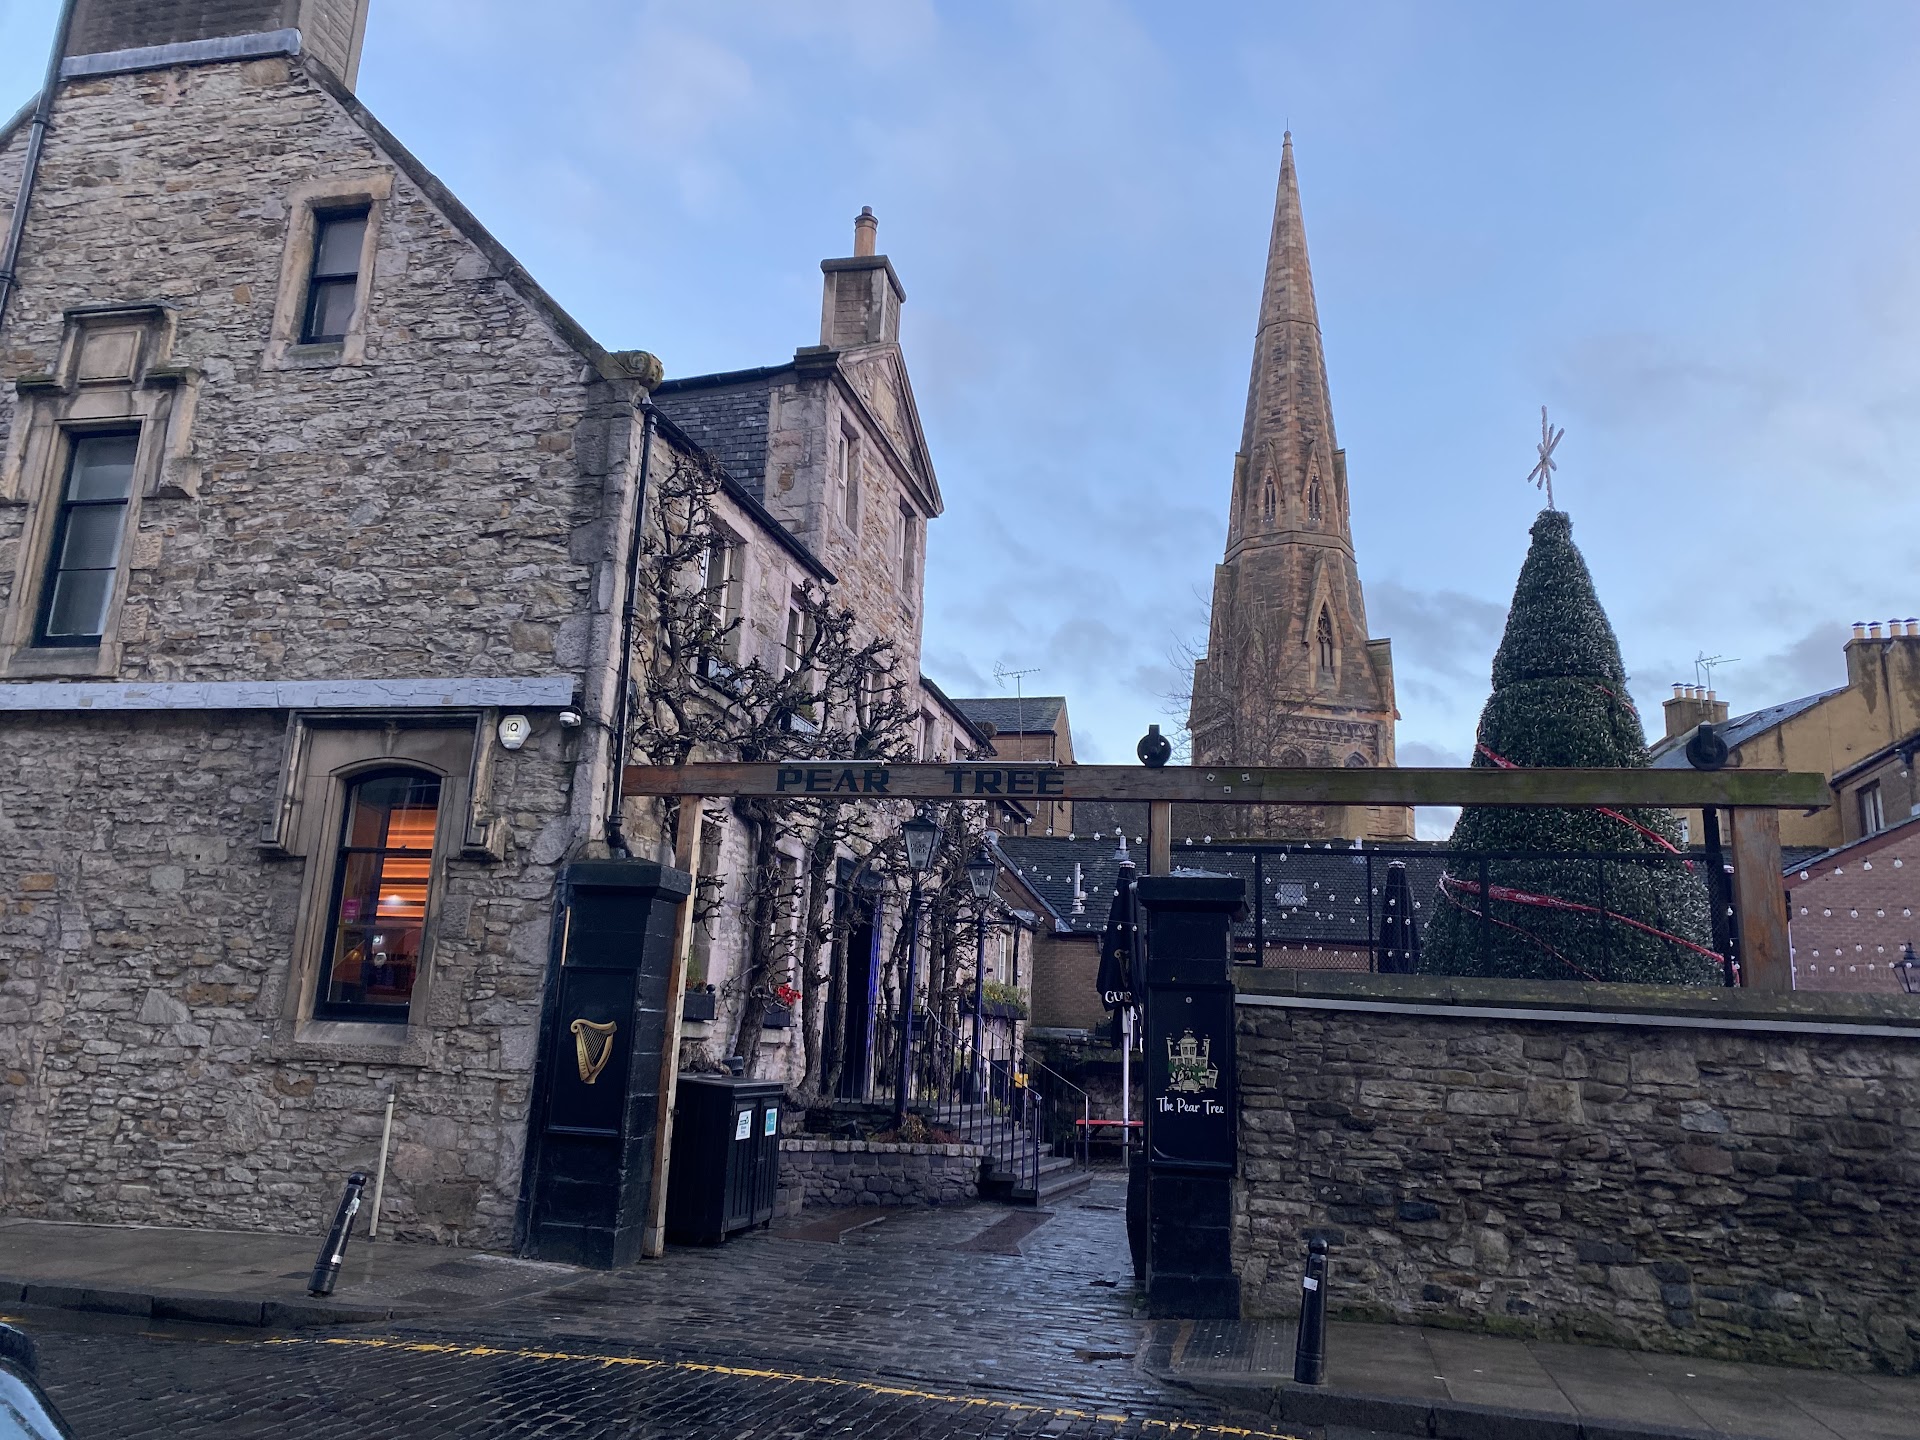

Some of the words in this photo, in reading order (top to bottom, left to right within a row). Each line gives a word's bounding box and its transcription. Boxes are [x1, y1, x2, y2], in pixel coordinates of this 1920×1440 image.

[507, 722, 519, 733] iQ
[776, 768, 891, 792] PEAR
[945, 770, 1064, 794] TREE
[1156, 1096, 1174, 1112] The
[1176, 1097, 1200, 1113] Pear
[1202, 1099, 1224, 1115] Tree
